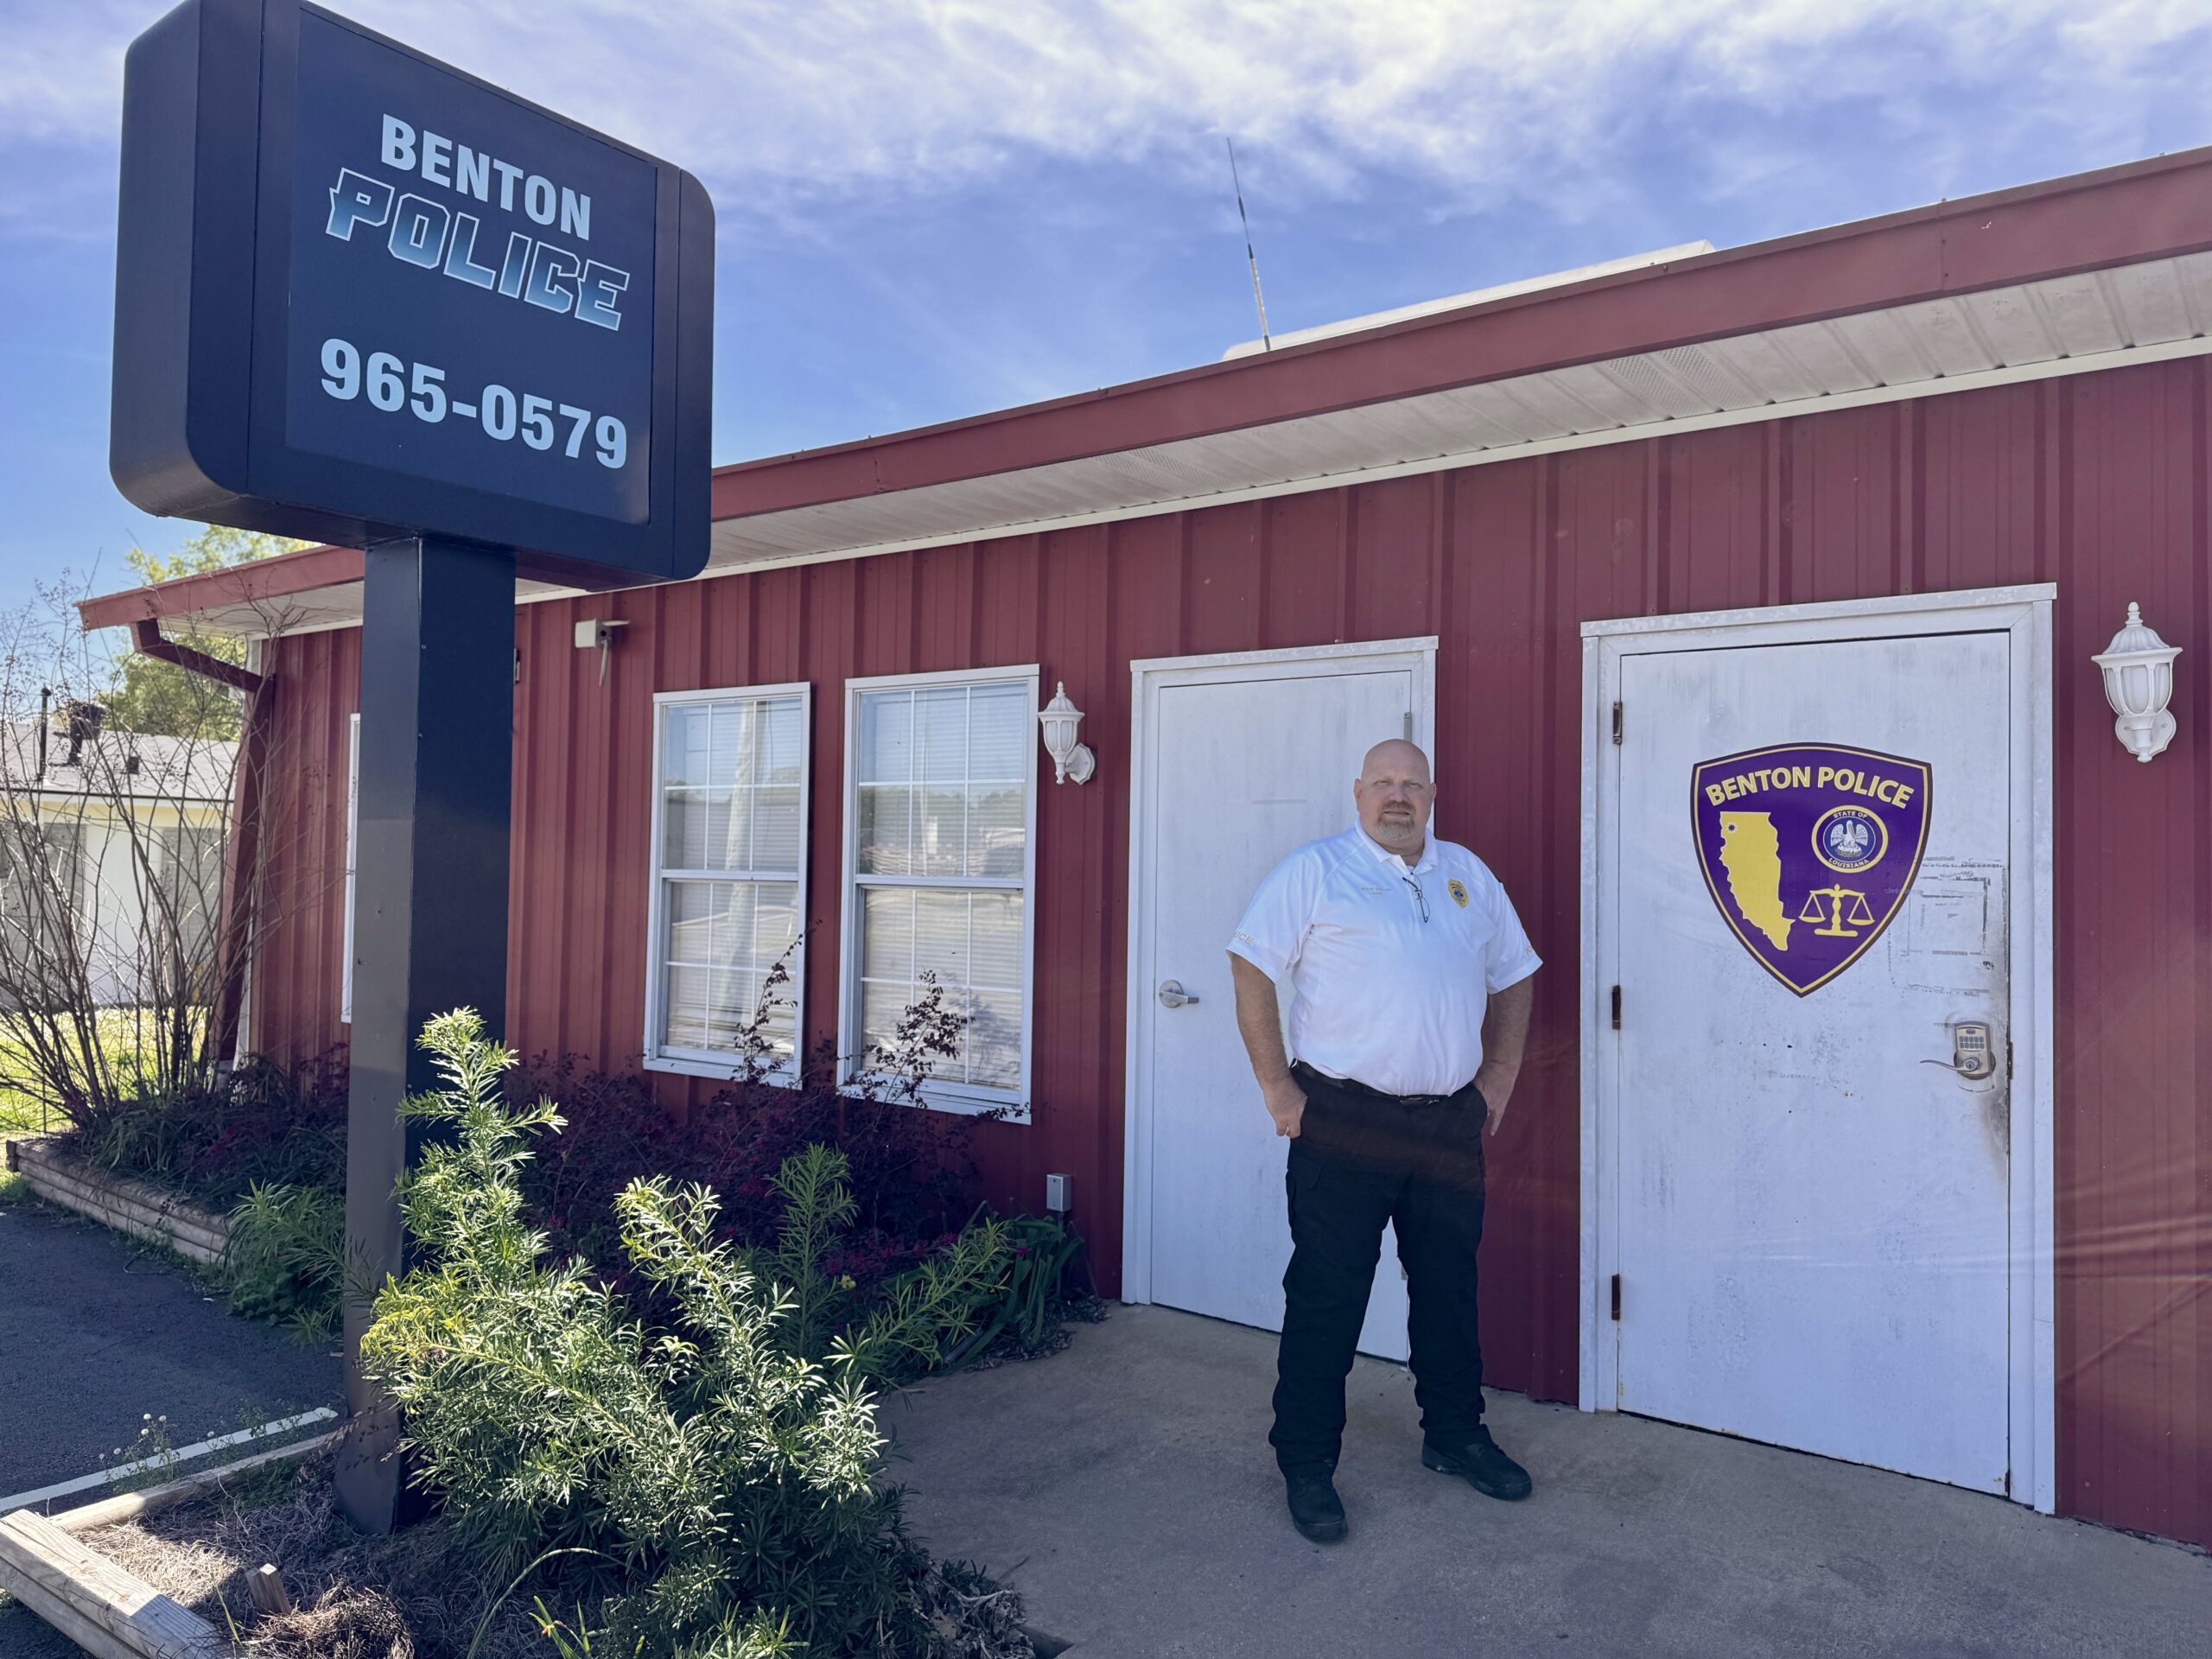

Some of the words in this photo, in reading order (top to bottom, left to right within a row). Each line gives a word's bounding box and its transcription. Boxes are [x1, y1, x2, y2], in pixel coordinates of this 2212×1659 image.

[381, 113, 591, 241] BENTON
[325, 167, 630, 332] POLICE
[321, 338, 627, 469] 965-0579
[1705, 766, 1811, 807] BENTON
[1817, 766, 1915, 810] POLICE
[1833, 810, 1856, 819] STATE
[1828, 857, 1870, 868] LOUISIANA
